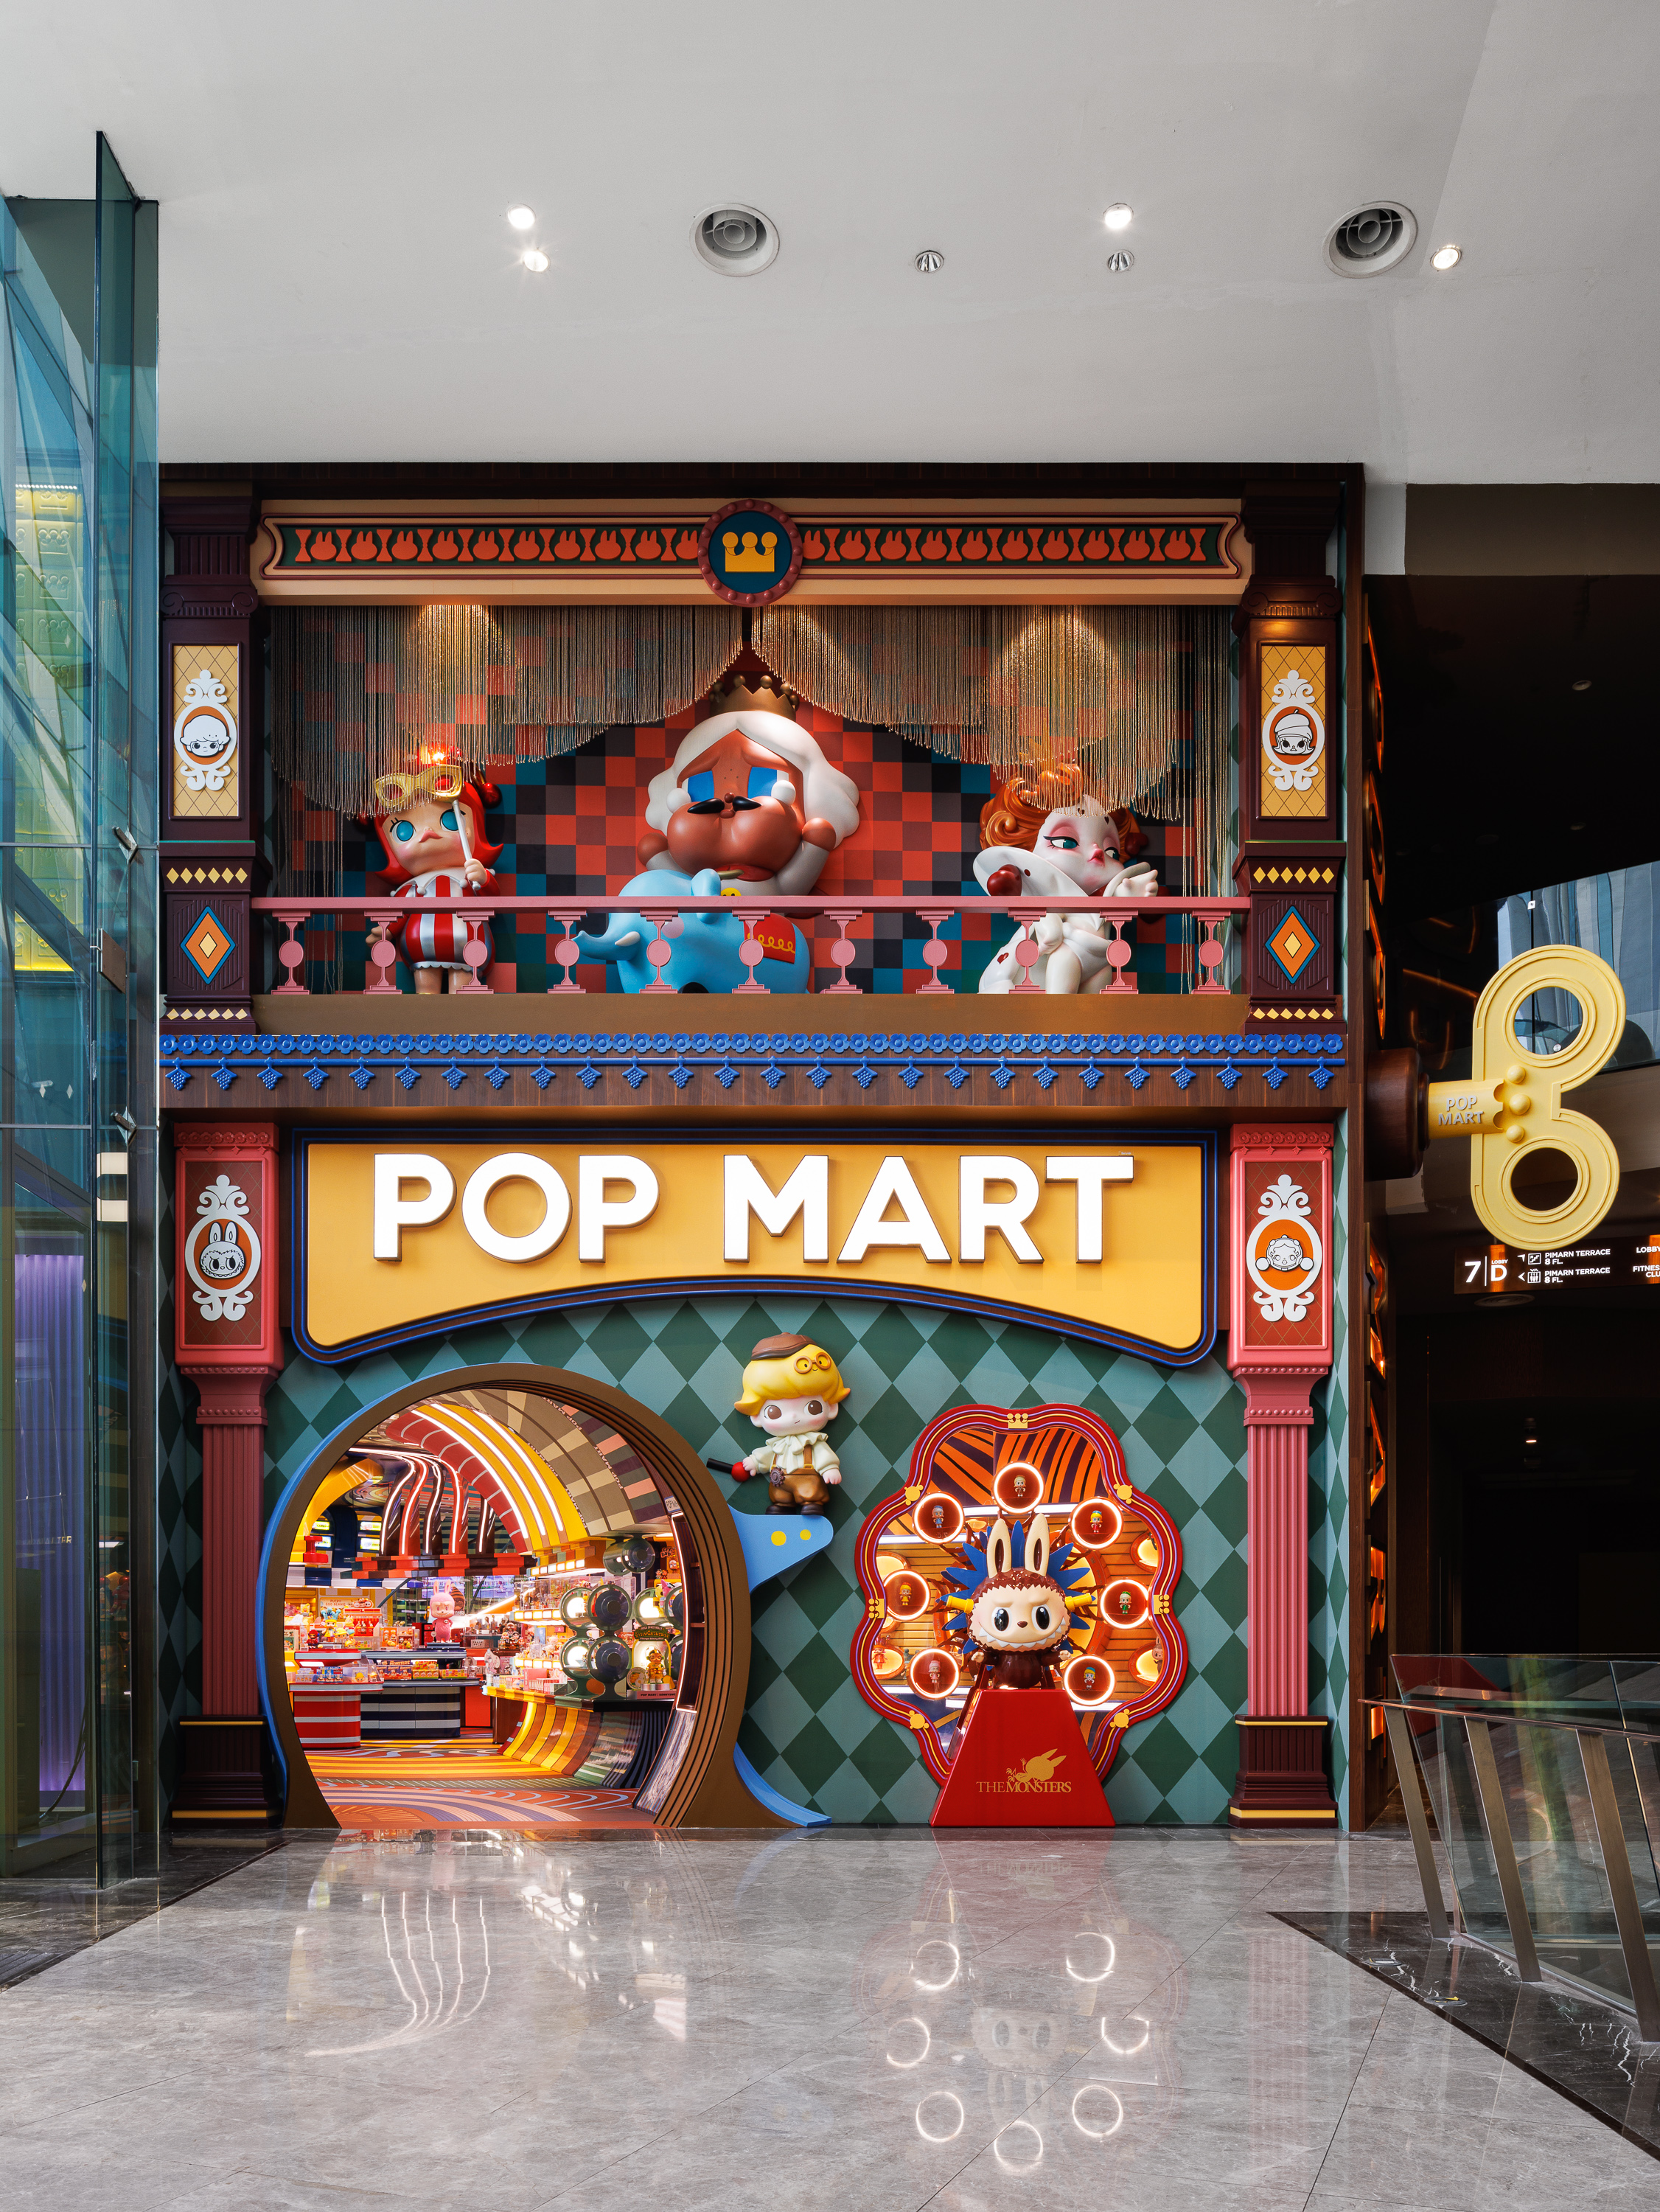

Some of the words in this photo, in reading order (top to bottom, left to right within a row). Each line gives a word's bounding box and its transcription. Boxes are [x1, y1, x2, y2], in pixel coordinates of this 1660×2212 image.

[1446, 1095, 1477, 1111] POP
[1438, 1111, 1484, 1126] MART
[374, 1152, 658, 1261] POP
[724, 1155, 1134, 1261] MART
[1575, 1248, 1611, 1257] TERRACE
[1465, 1260, 1482, 1283] 7
[1490, 1264, 1507, 1281] D
[1575, 1267, 1611, 1275] TERRACE
